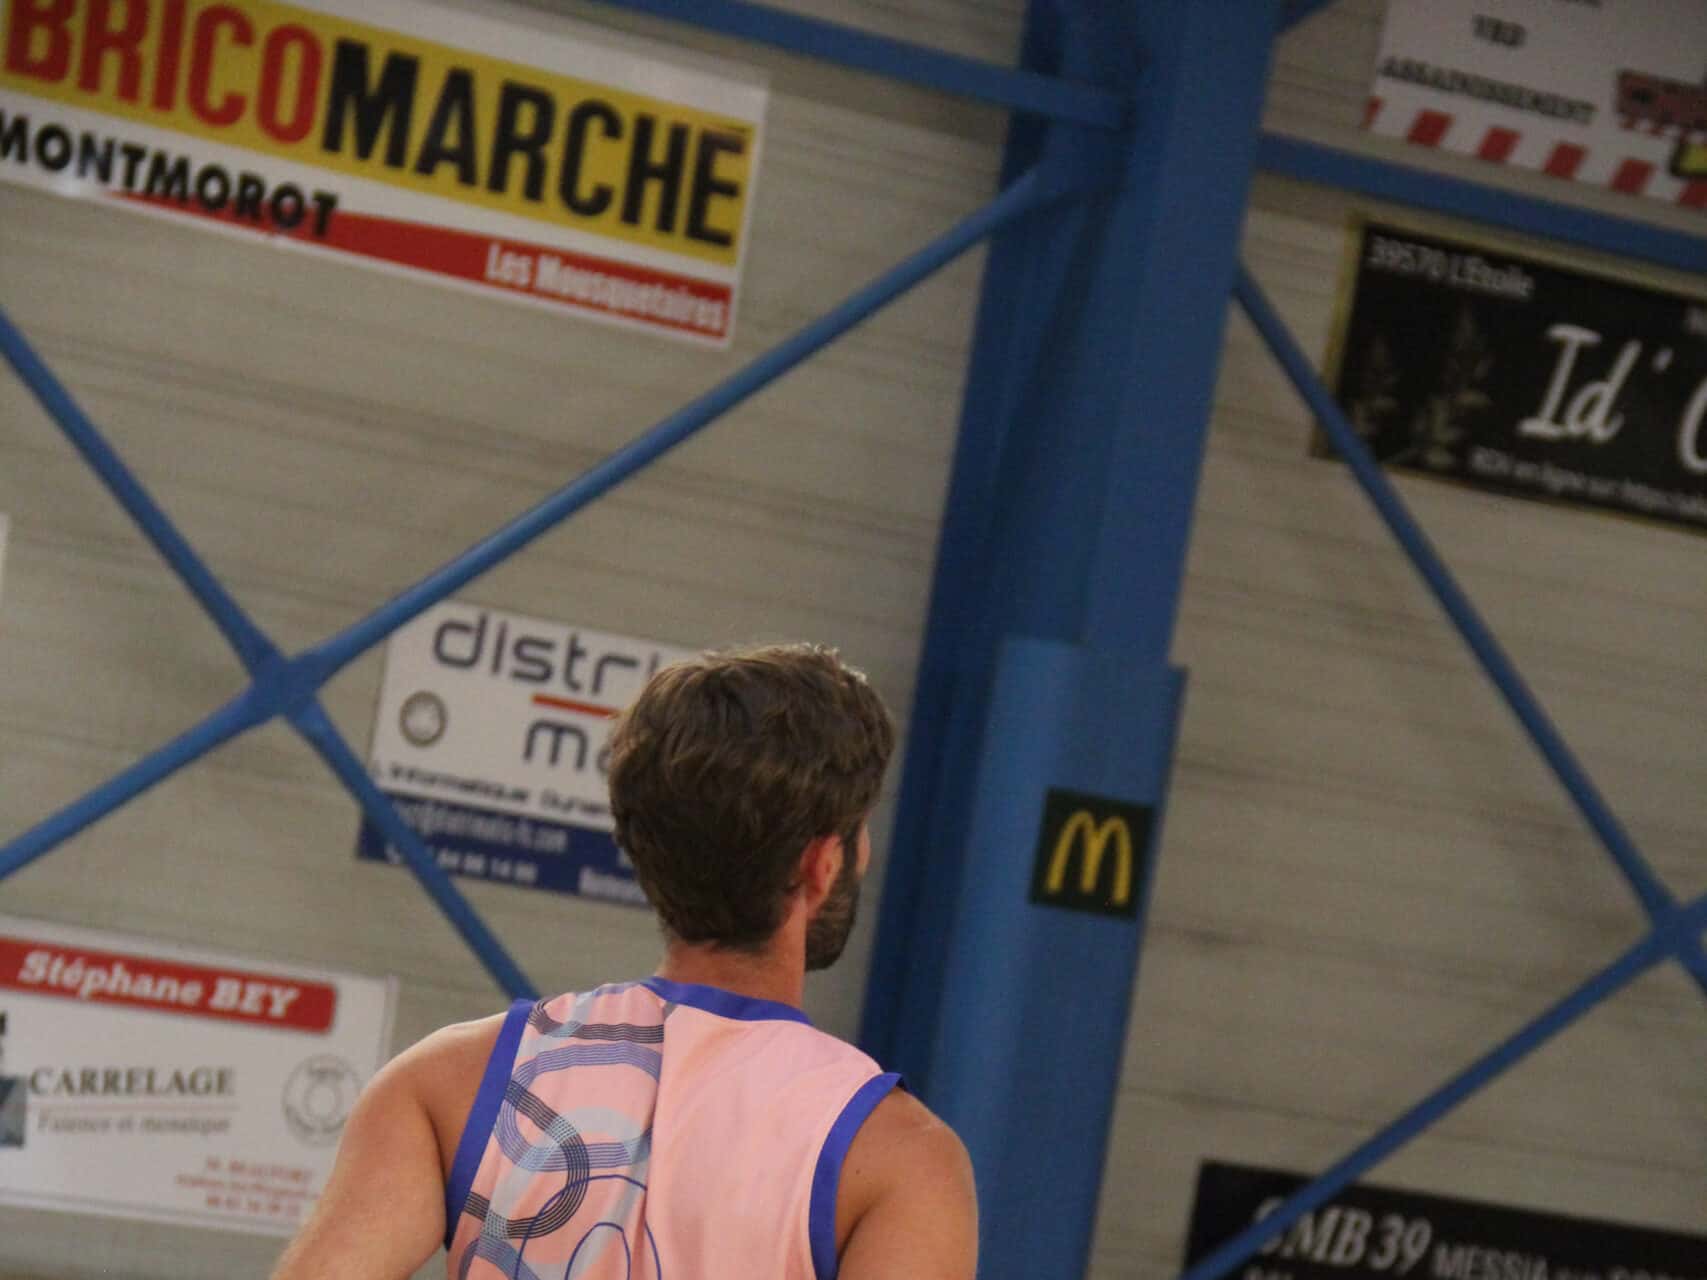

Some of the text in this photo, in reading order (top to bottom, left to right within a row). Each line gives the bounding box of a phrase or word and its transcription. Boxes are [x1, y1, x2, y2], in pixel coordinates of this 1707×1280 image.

[0, 110, 339, 236] MONTMOROT
[484, 242, 726, 331] Les Mousquetaires
[17, 949, 301, 1019] Stéphane BEY
[30, 1066, 236, 1098] CARRELAGE
[1367, 1212, 1433, 1277] 39
